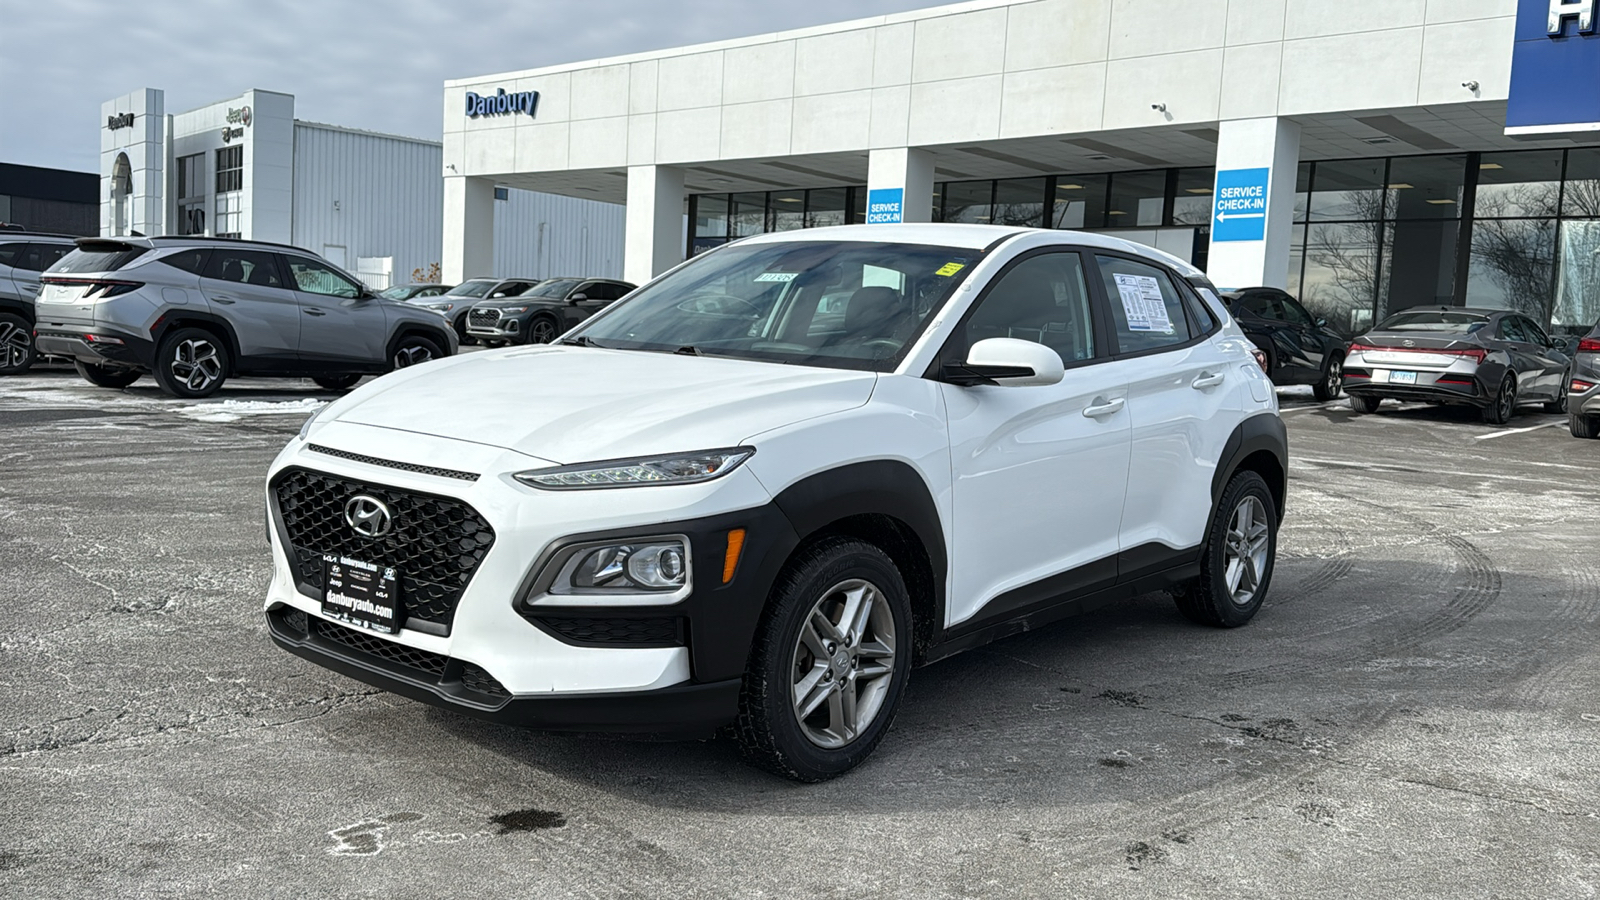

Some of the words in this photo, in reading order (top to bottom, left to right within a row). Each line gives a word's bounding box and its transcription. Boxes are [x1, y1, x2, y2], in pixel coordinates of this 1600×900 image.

[465, 87, 540, 117] Danbury
[108, 112, 134, 131] Danbury
[1221, 186, 1262, 198] SERVICE
[871, 203, 899, 212] SERVICE
[1217, 198, 1264, 210] CHECK-IN
[869, 213, 900, 222] CHECK-IN
[341, 556, 377, 571] danburyauto.com
[329, 578, 342, 587] Jeep
[326, 589, 393, 619] danburyauto.com
